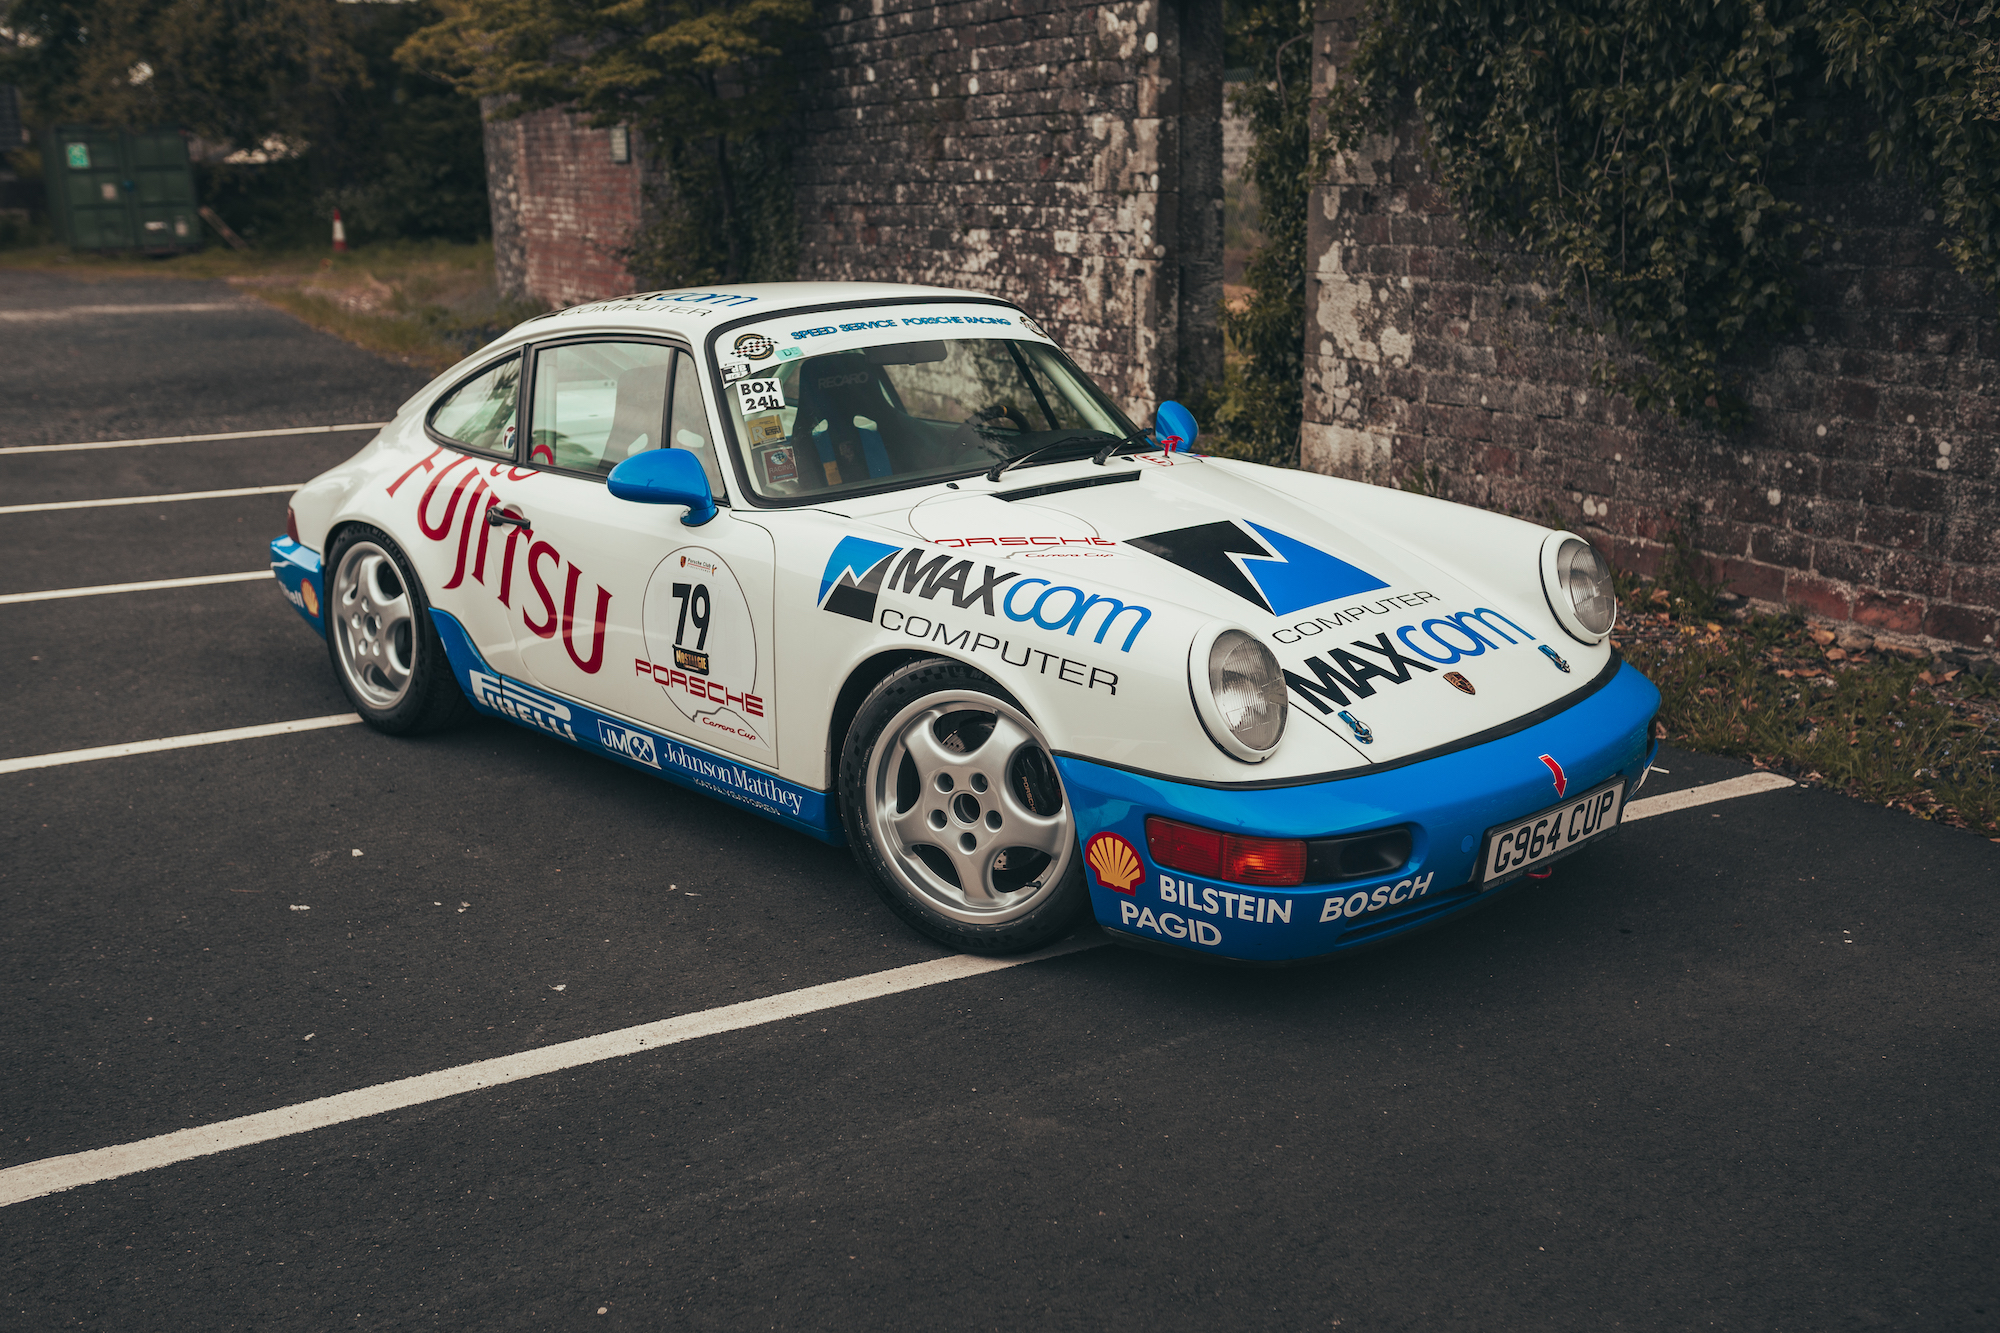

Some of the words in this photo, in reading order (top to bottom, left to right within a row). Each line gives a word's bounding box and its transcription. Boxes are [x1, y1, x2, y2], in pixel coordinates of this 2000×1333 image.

[560, 302, 713, 317] COMPUTER
[791, 326, 837, 340] SPEED
[839, 319, 898, 332] SERVICE
[901, 316, 964, 326] PORSCHE
[963, 316, 1011, 326] RACING
[740, 381, 777, 395] BOX
[745, 395, 780, 411] 24h
[818, 371, 868, 390] RECARO
[768, 463, 795, 474] RACING
[386, 446, 613, 674] FUJITSU
[922, 536, 1117, 548] ORSCHE
[672, 582, 711, 652] 79
[1272, 591, 1441, 644] COMPUTER
[879, 608, 1120, 696] COMPUTER
[469, 669, 578, 742] PIRELLI
[635, 658, 764, 717] PORSCHE
[702, 717, 736, 734] Carrera
[737, 728, 756, 741] Cup
[664, 742, 734, 785] Johnson
[732, 765, 803, 815] Matthey
[1494, 812, 1563, 874] G964
[1567, 790, 1615, 843] CUP
[1159, 874, 1293, 924] BILSTEIN
[1318, 871, 1435, 923] BOSCH
[1120, 900, 1223, 946] PAGID
